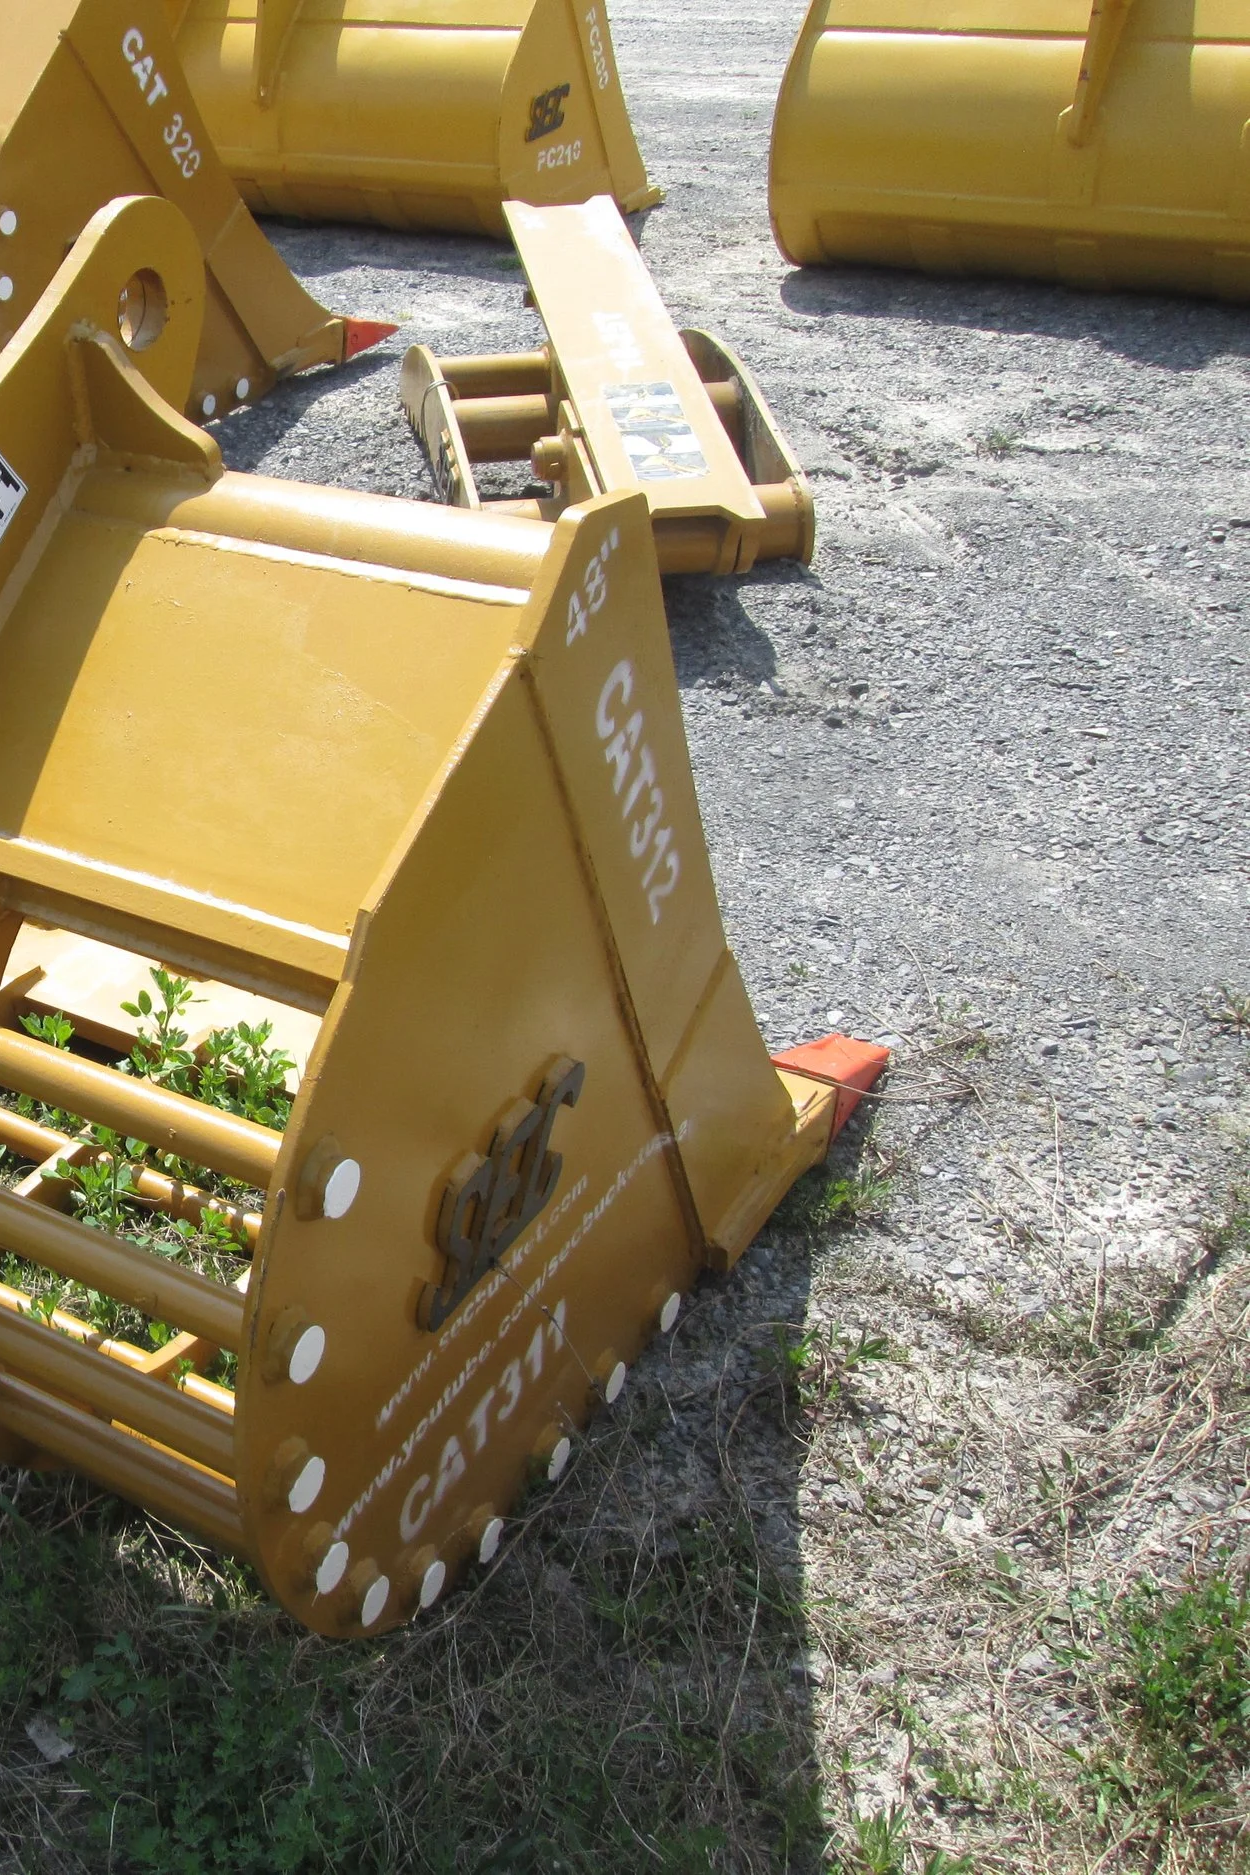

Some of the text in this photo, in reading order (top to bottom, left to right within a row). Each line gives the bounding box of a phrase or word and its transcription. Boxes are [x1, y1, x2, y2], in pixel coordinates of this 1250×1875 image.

[122, 27, 200, 179] CAT 320
[525, 83, 570, 143] SEC
